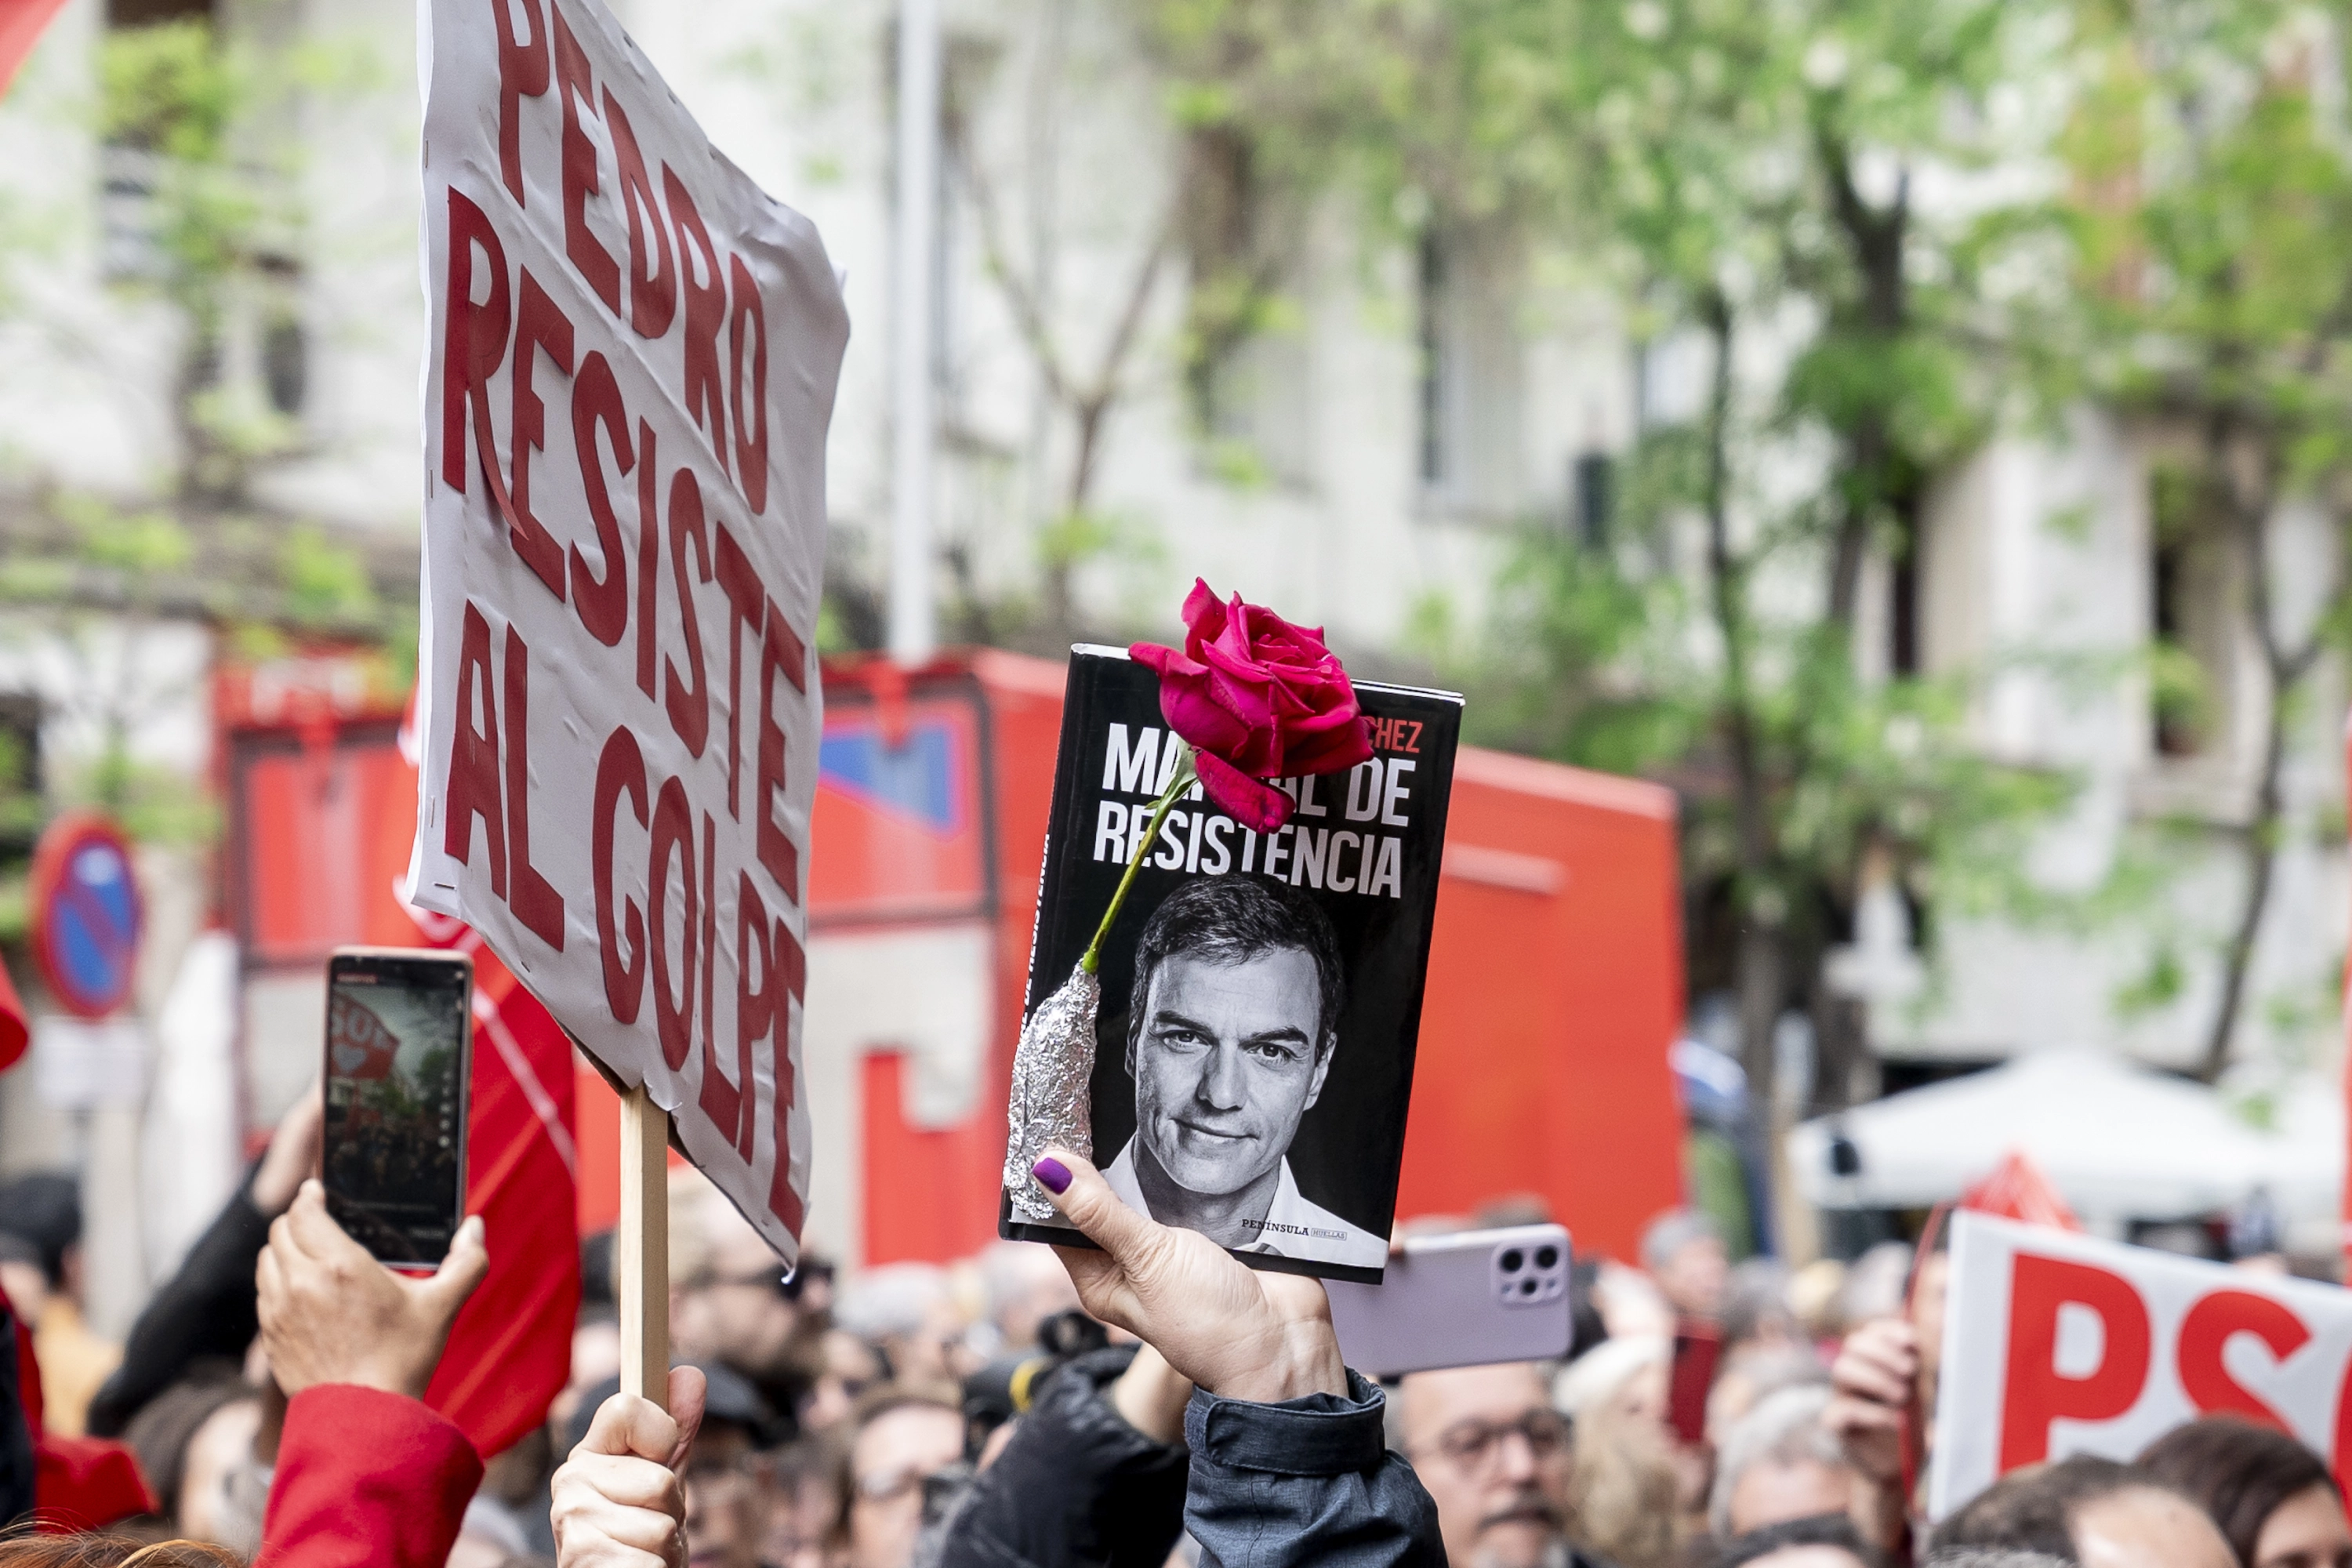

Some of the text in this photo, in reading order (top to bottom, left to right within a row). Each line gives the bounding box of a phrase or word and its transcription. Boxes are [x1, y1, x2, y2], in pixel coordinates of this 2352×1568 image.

[492, 0, 768, 516] PEDRO
[442, 185, 805, 907] RESISTE
[445, 600, 806, 1244] AL GOLPE
[1094, 800, 1402, 898] RESISTENCIA
[1345, 757, 1416, 827] DE
[1241, 1218, 1345, 1240] PENÍNSULA HUELLAS
[1996, 1251, 2352, 1529] PS
